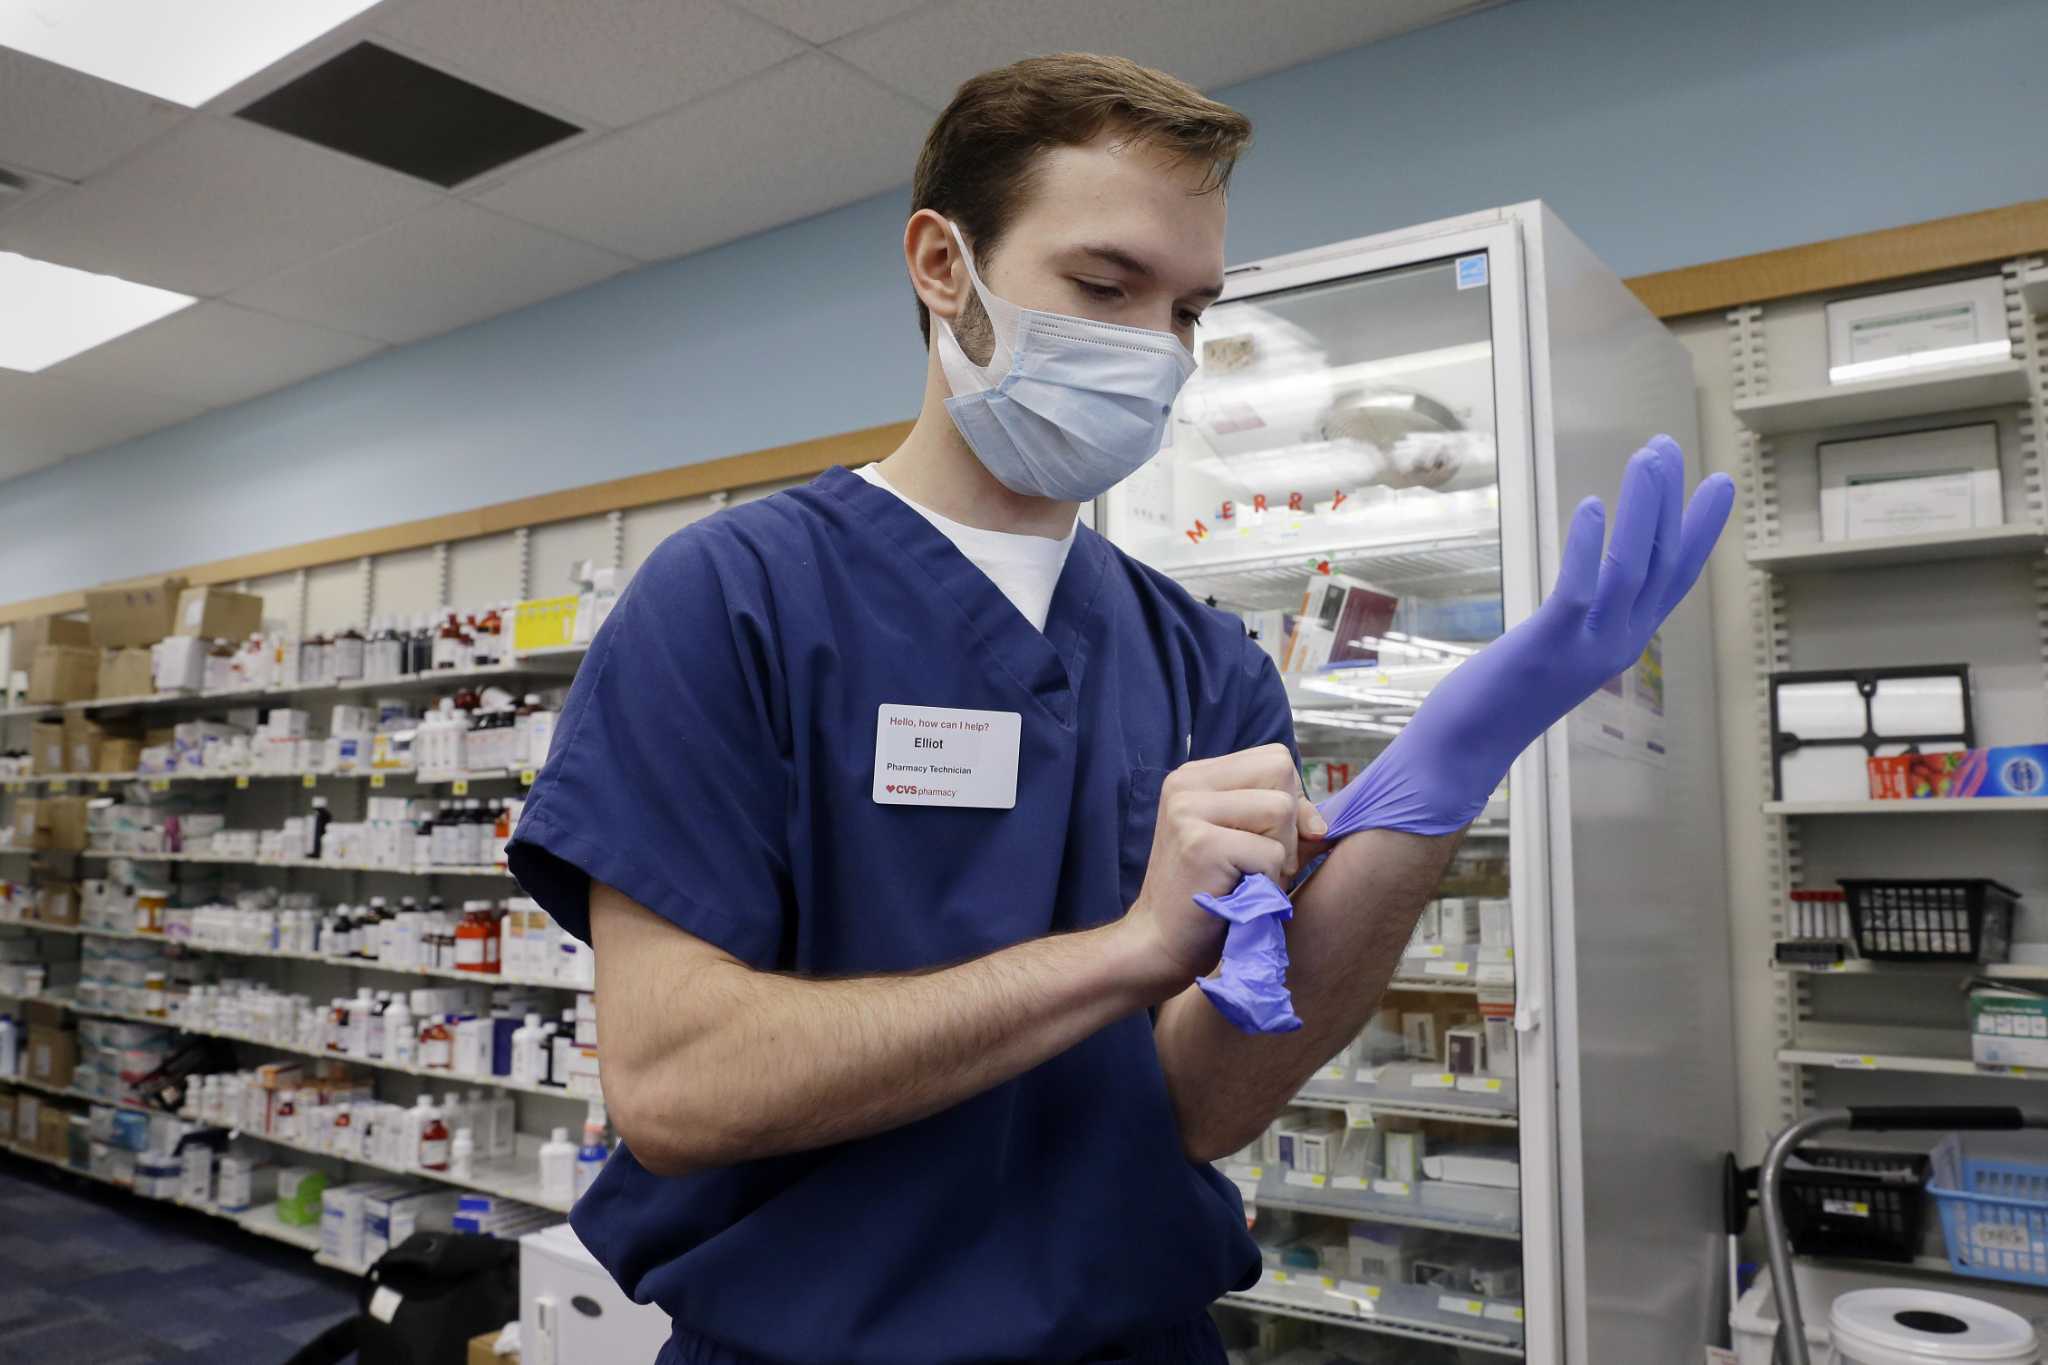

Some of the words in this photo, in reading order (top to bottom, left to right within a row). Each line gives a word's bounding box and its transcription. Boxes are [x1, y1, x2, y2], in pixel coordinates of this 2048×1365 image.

[1185, 489, 1348, 545] MERRY
[889, 716, 917, 728] Hello,
[918, 718, 938, 728] how
[940, 720, 957, 729] can
[964, 721, 990, 732] help?
[914, 737, 944, 749] Elliot
[886, 762, 928, 774] Pharmacy
[929, 764, 972, 774] Technician
[895, 784, 917, 795] CVS
[917, 788, 957, 798] pharmacy
